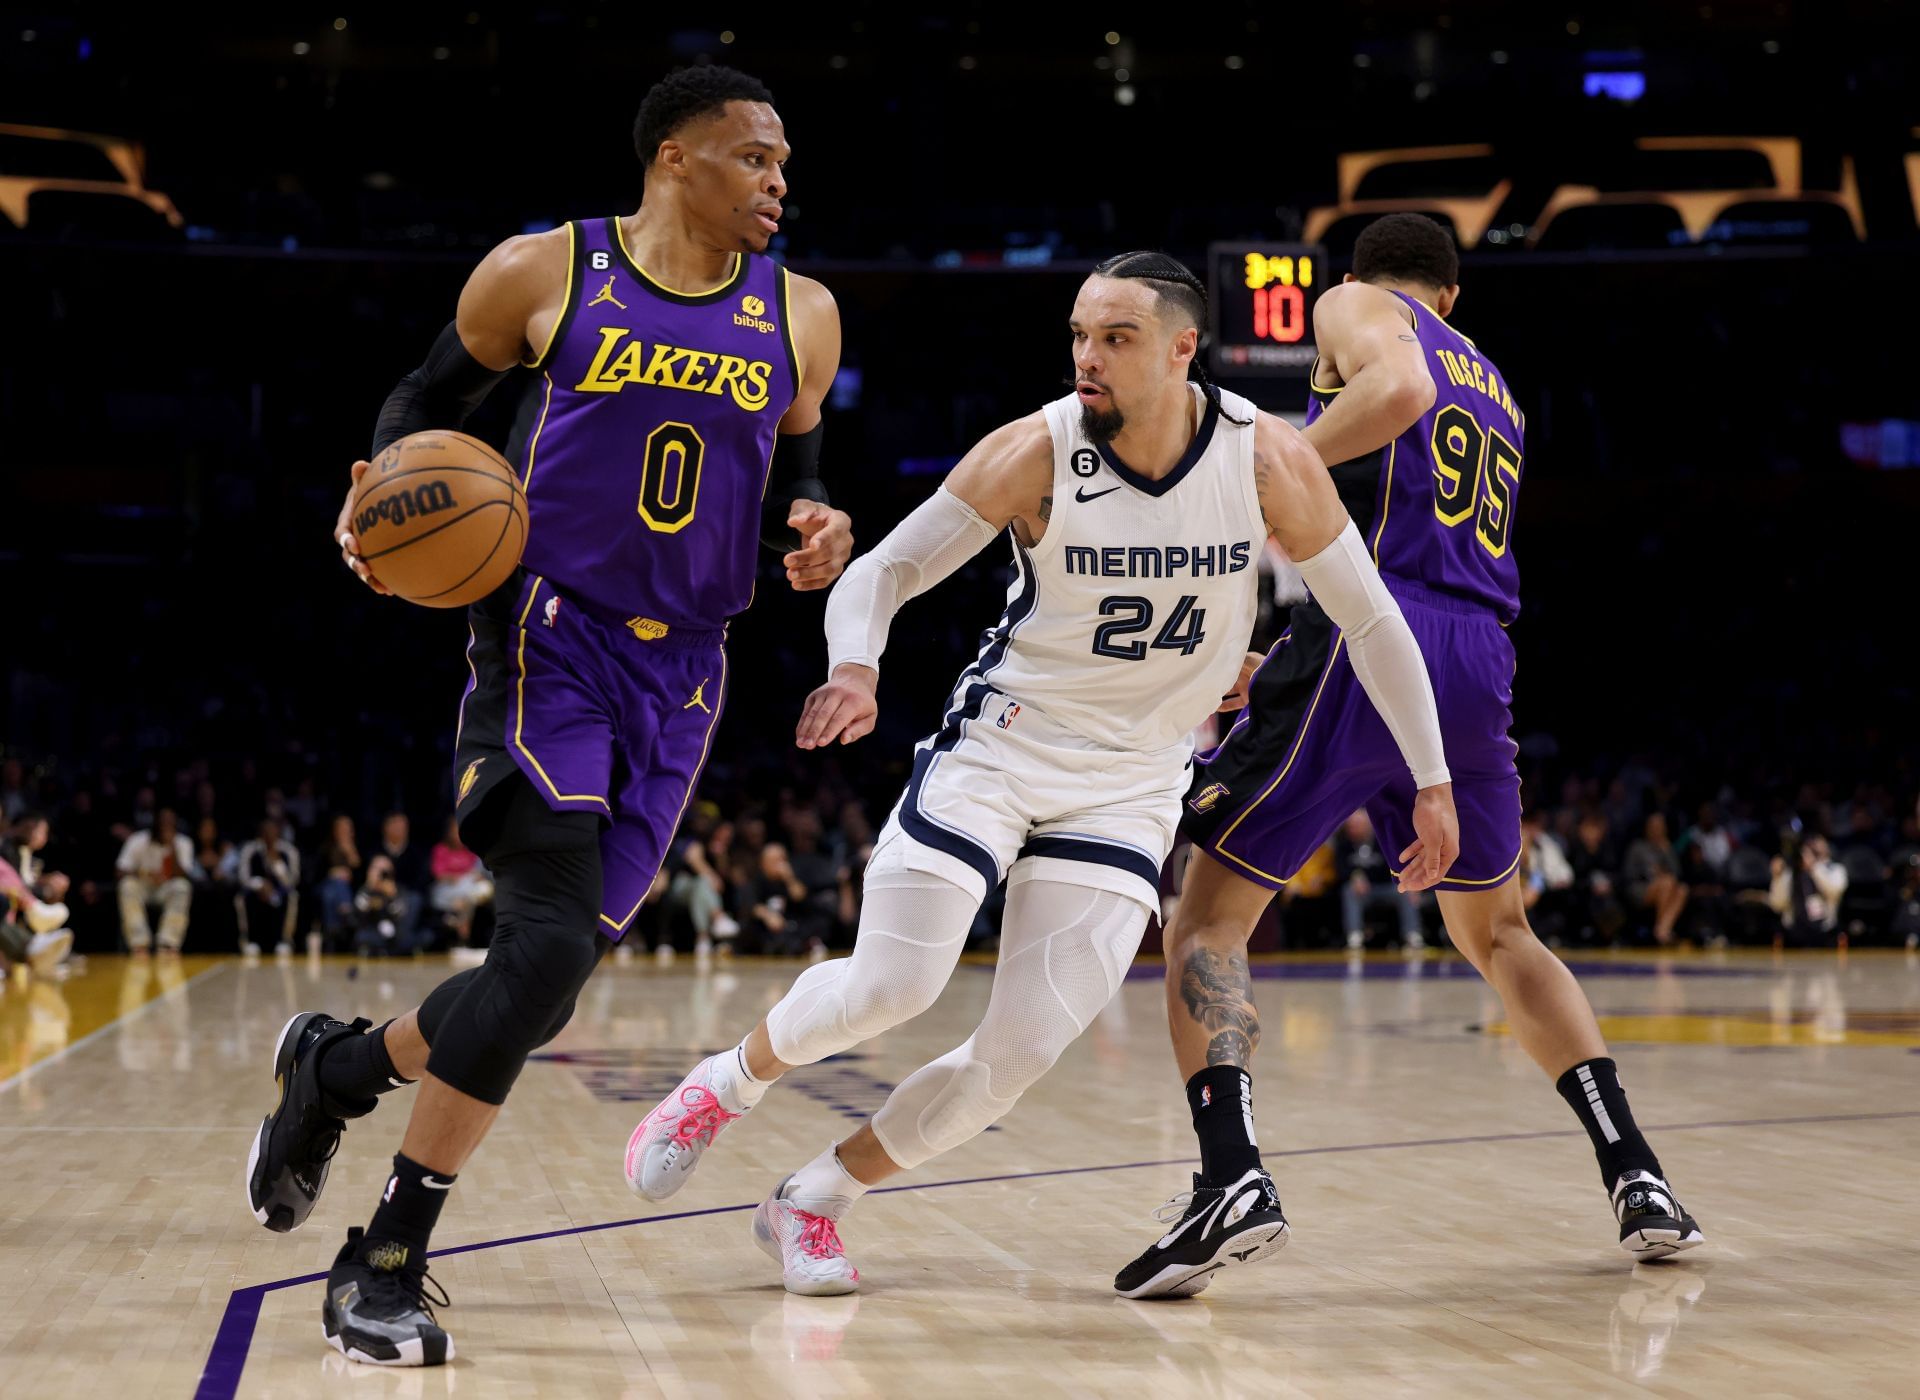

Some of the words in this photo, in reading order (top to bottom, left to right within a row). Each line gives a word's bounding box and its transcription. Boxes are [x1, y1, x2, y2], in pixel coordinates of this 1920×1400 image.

[592, 252, 609, 270] 6
[733, 313, 775, 333] bibigo
[1253, 285, 1304, 342] 10
[574, 326, 773, 412] LAKERS
[637, 420, 705, 534] 0
[1077, 452, 1093, 475] 6
[1431, 403, 1523, 559] 95
[355, 480, 459, 536] Wilson
[1065, 541, 1250, 578] MEMPHIS
[1092, 595, 1206, 661] 24
